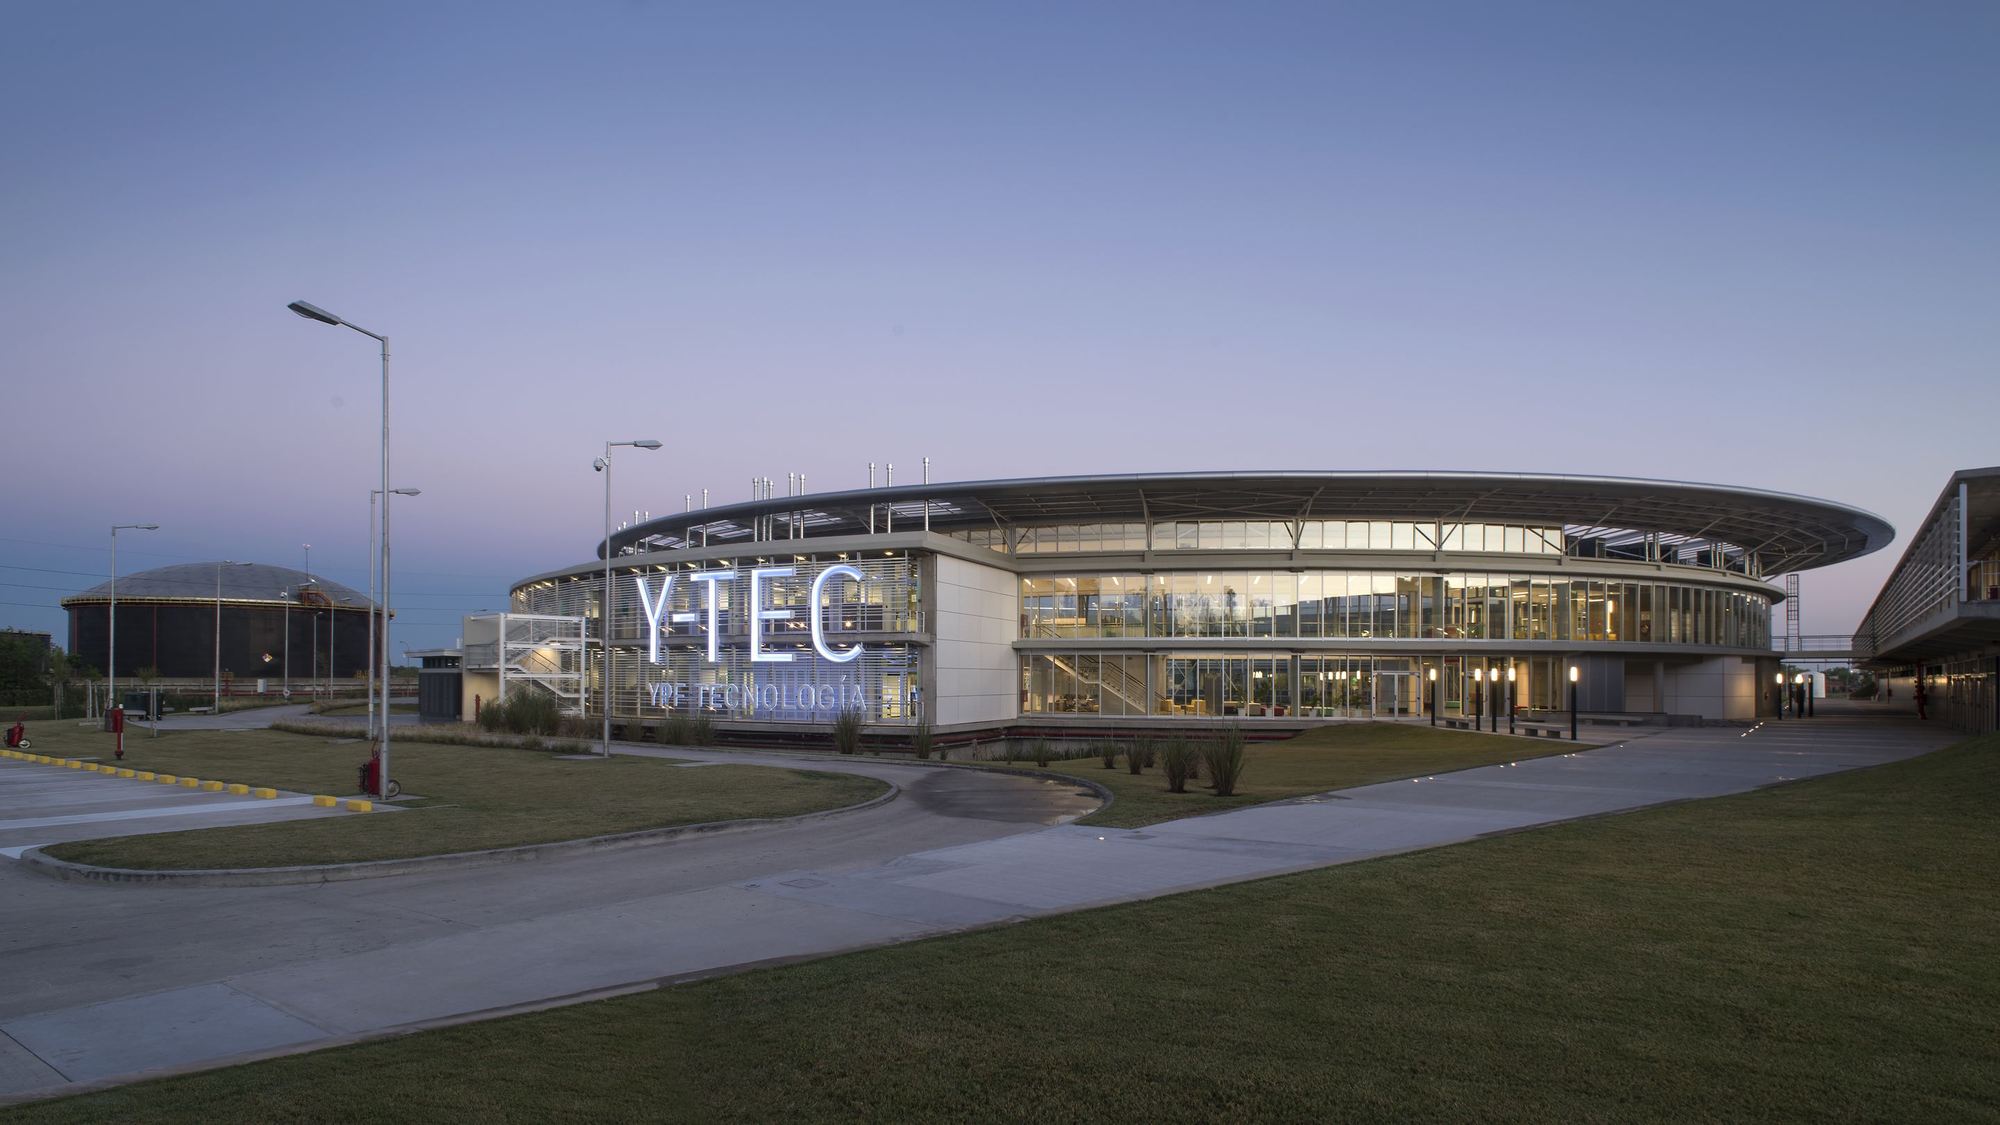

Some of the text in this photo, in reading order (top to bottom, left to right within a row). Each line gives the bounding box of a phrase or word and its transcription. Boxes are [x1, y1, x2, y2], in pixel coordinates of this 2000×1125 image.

[636, 565, 865, 663] Y-TEC
[648, 675, 867, 711] YPF TECNOLOGÍA
